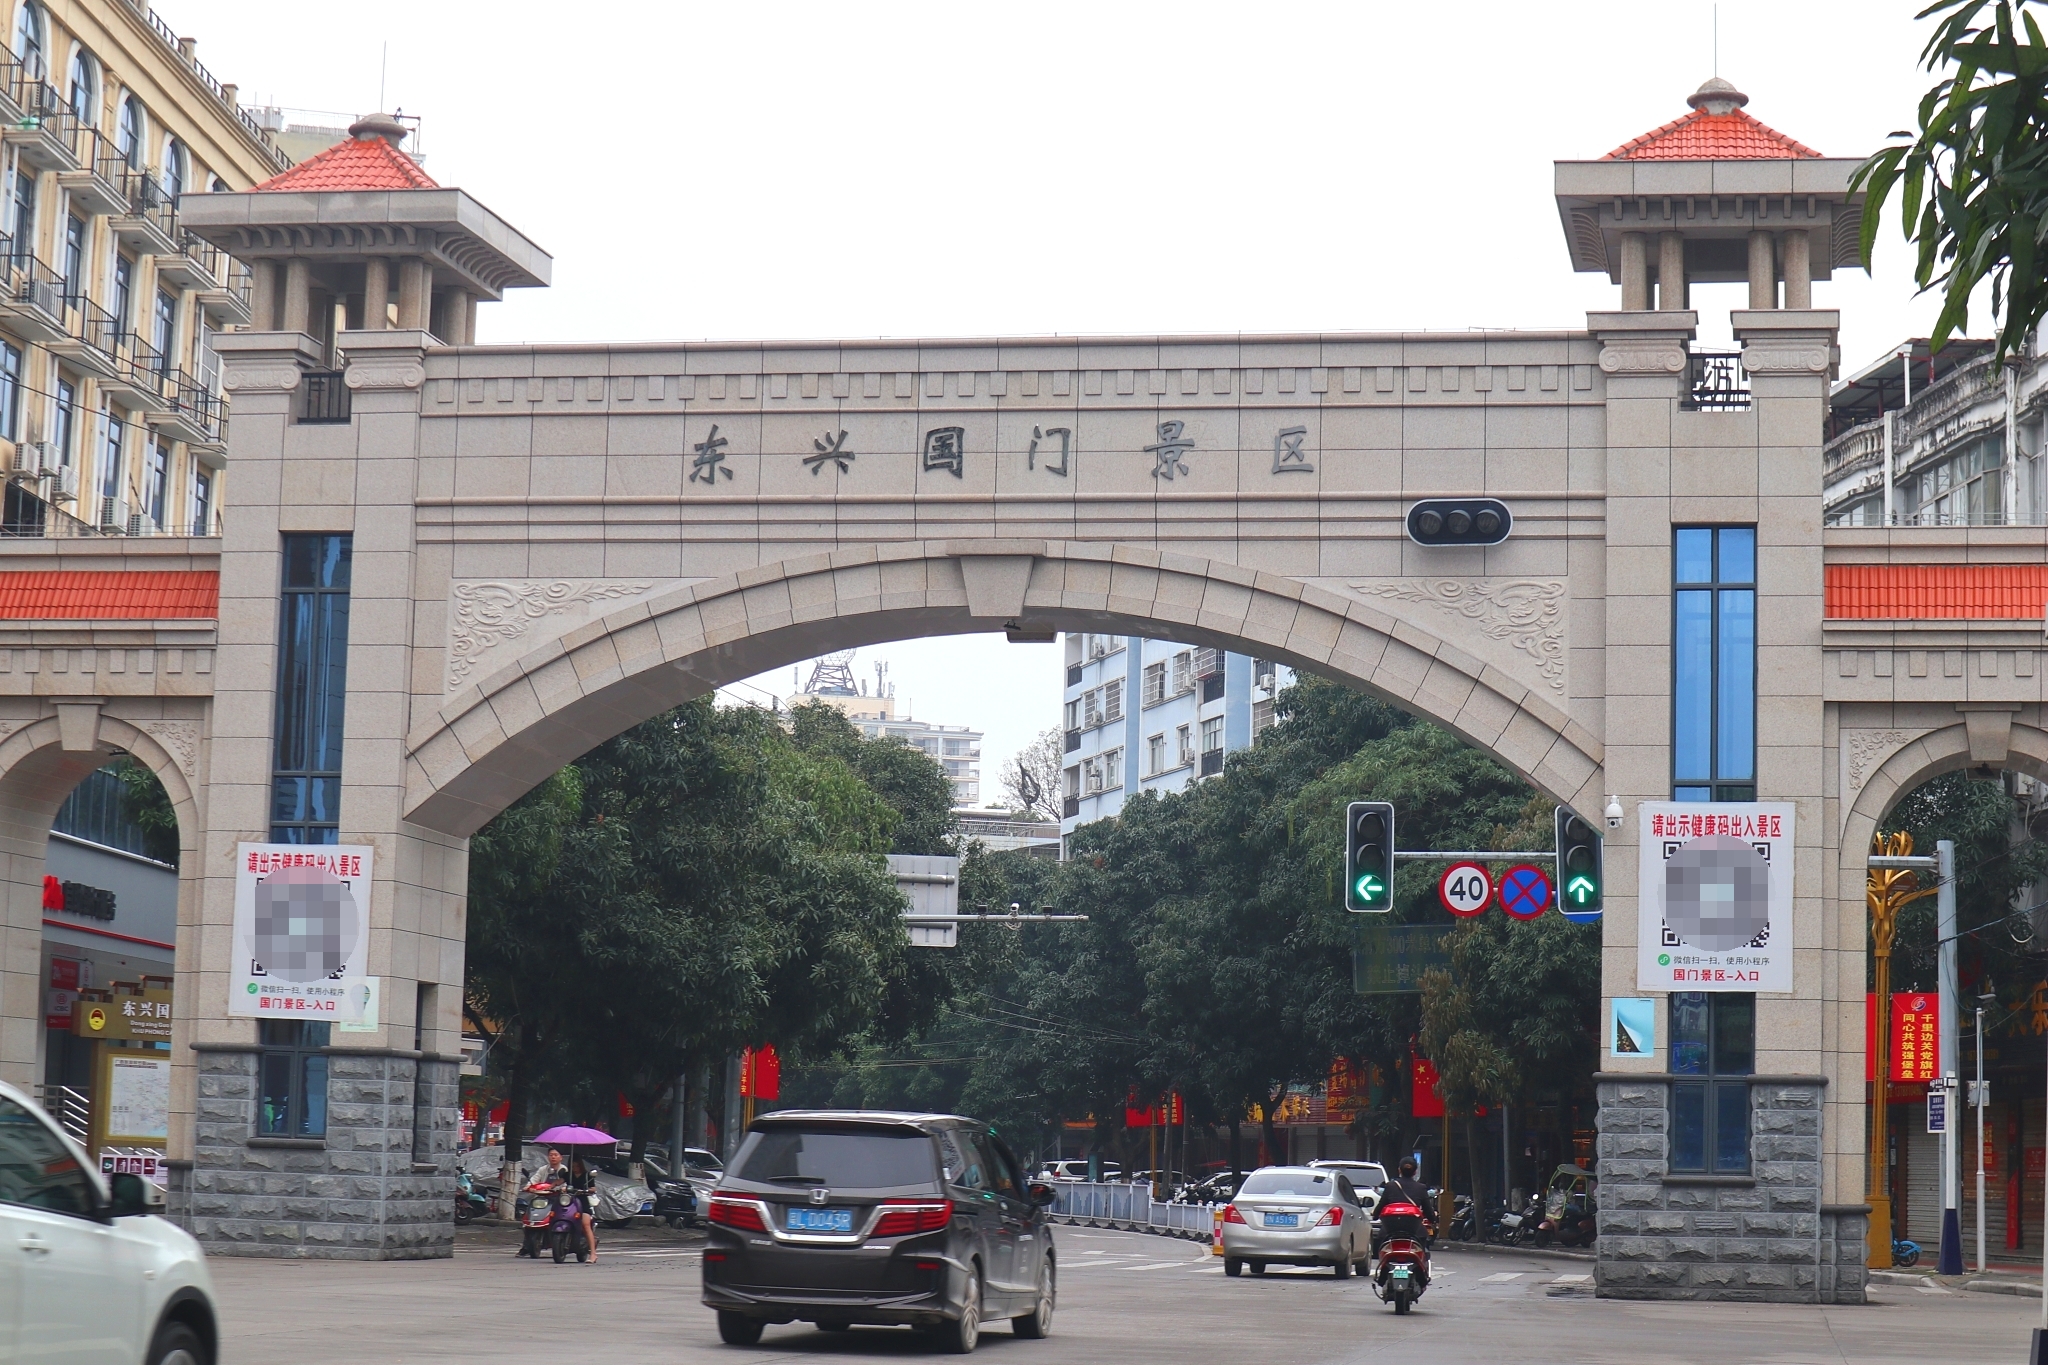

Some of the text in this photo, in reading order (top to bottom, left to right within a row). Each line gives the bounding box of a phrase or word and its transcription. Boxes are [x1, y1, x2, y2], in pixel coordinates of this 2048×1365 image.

[689, 419, 1314, 485] 东兴国门景区
[1652, 813, 1781, 838] 请出示健康码出入景区
[1449, 876, 1484, 901] 40
[1901, 1013, 1916, 1079] 同心共筑强堡垒
[1919, 1013, 1934, 1079] 千里边关党旗红
